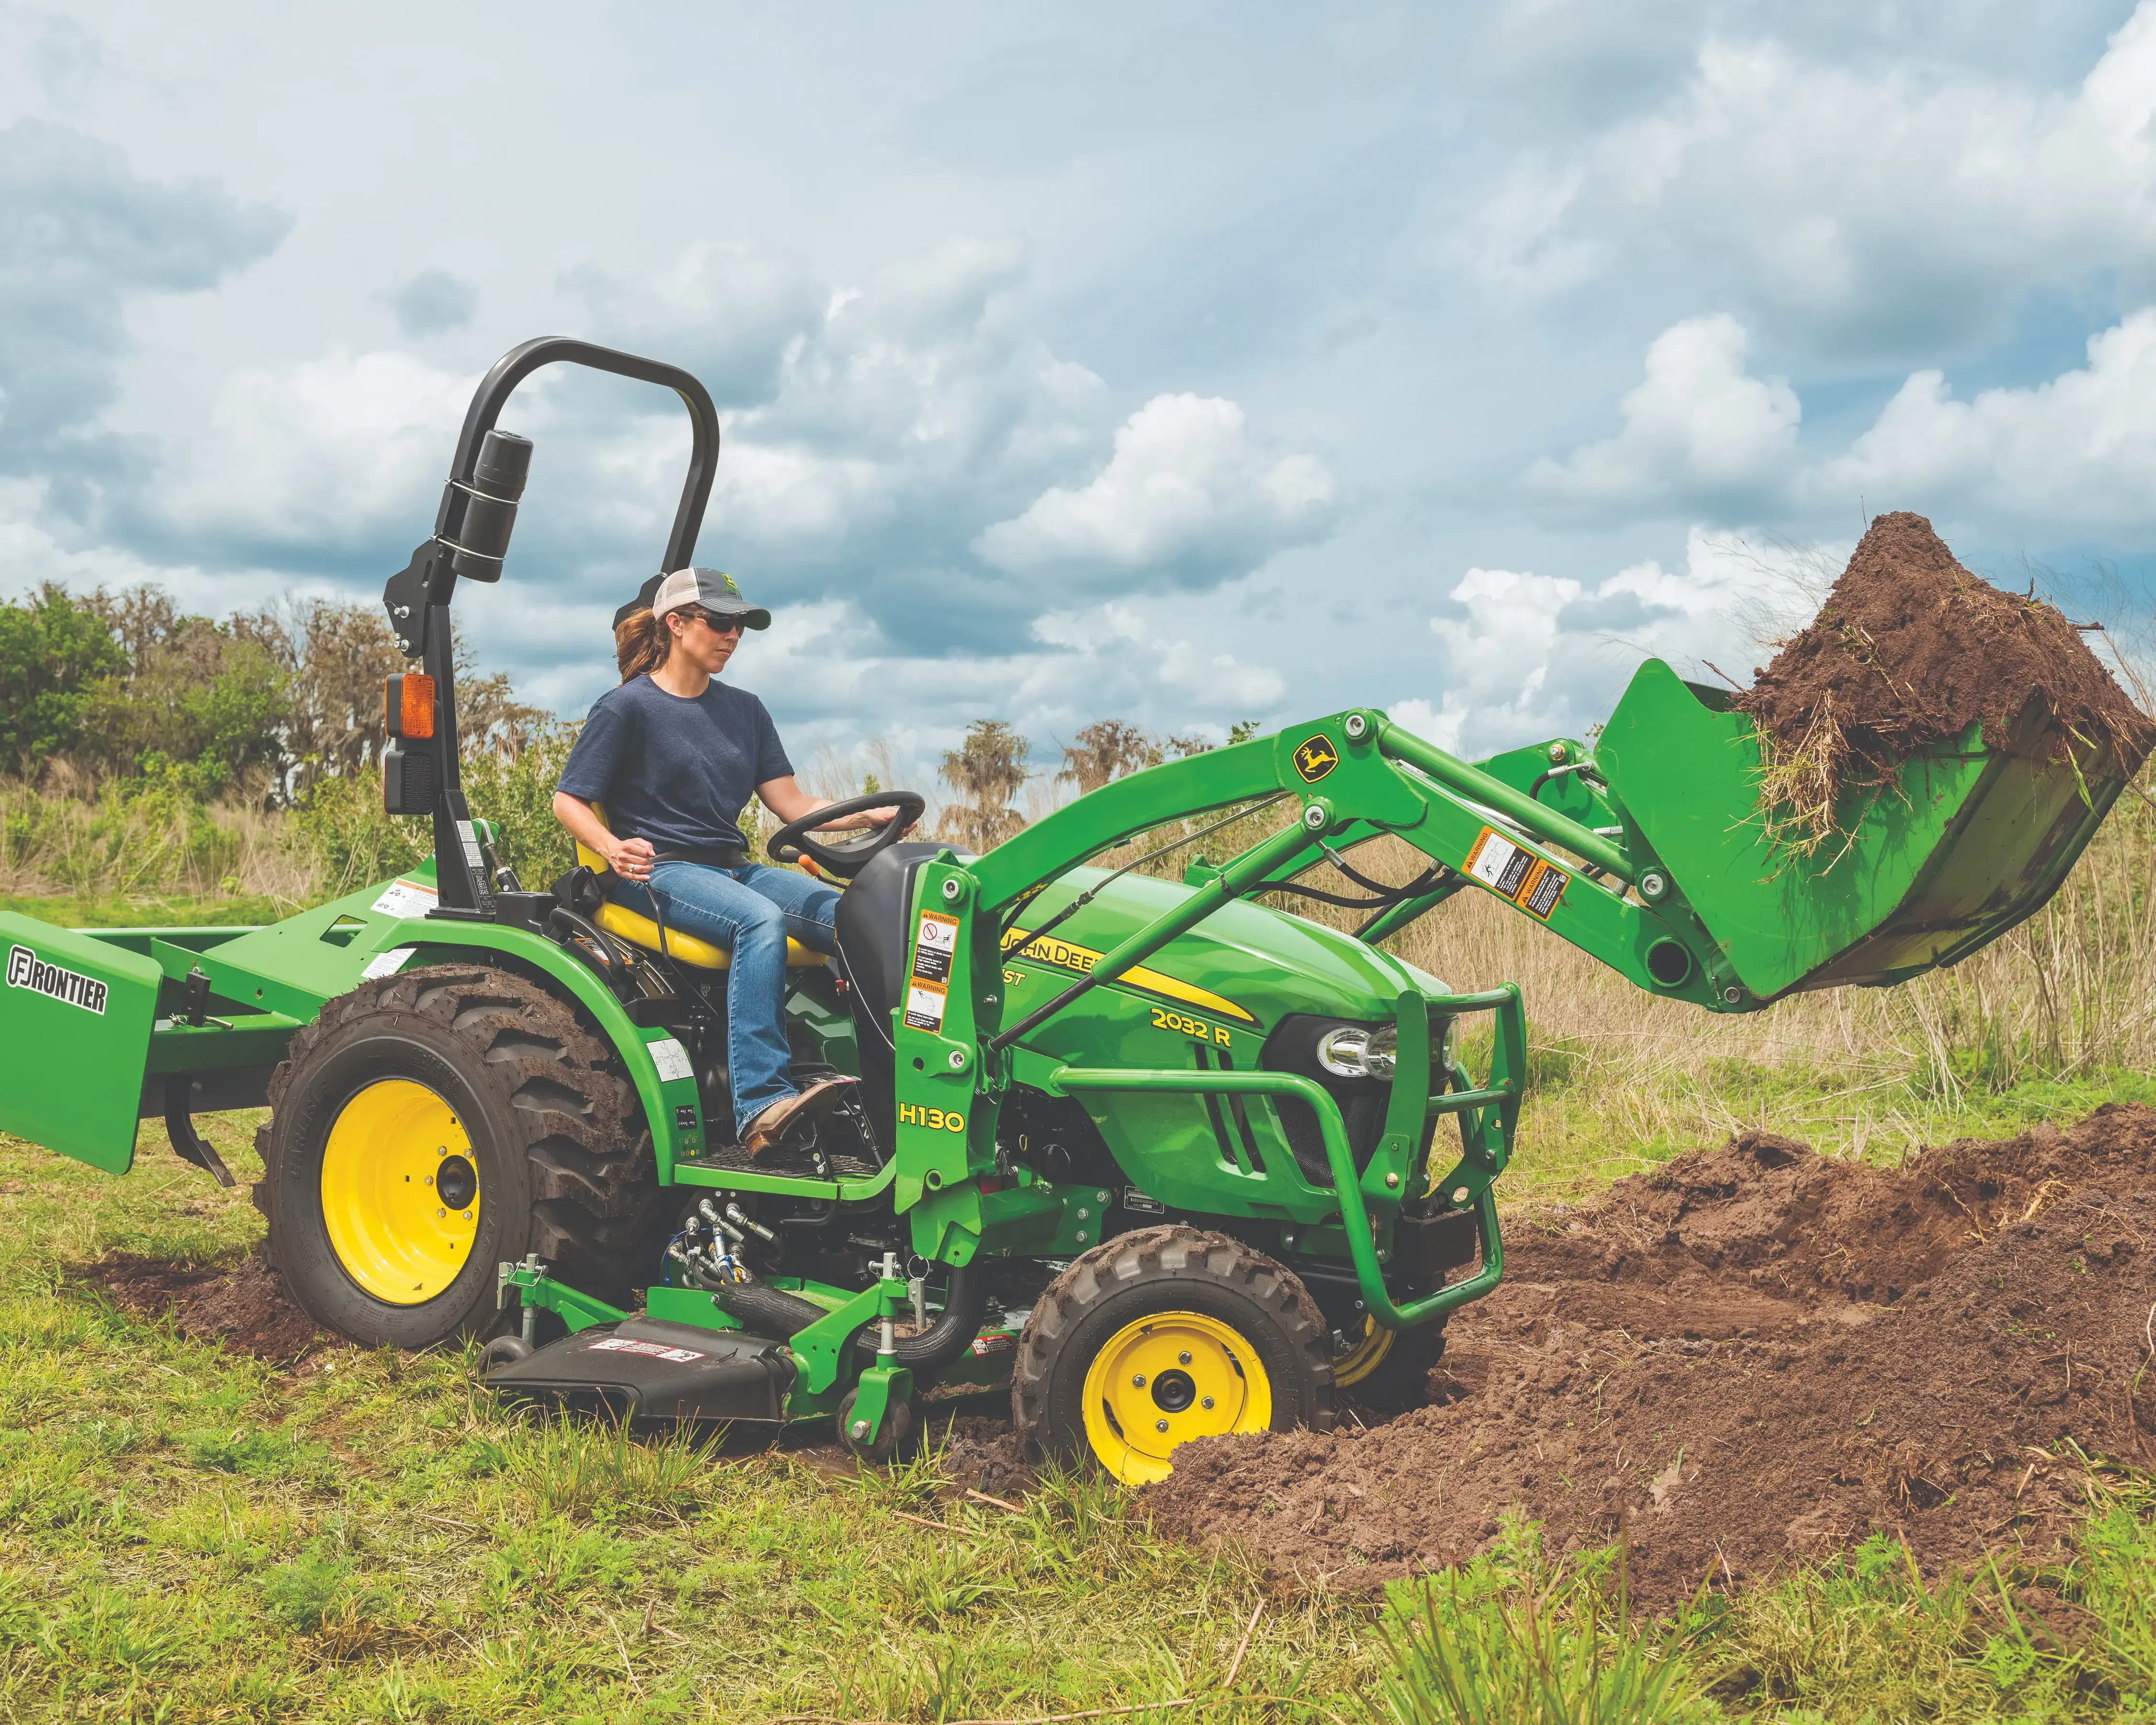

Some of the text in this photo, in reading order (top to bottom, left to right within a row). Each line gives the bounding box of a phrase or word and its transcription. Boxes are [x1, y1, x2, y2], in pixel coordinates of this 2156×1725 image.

[1470, 832, 1488, 861] WARNING
[1526, 866, 1545, 894] WARNING
[929, 913, 957, 925] WARNING
[1055, 945, 1099, 970] DEE
[8, 946, 106, 1012] FRONTIER
[917, 982, 945, 993] WARNING
[1002, 968, 1026, 986] ST
[1150, 1008, 1232, 1048] 2032 R
[899, 1102, 965, 1133] H130
